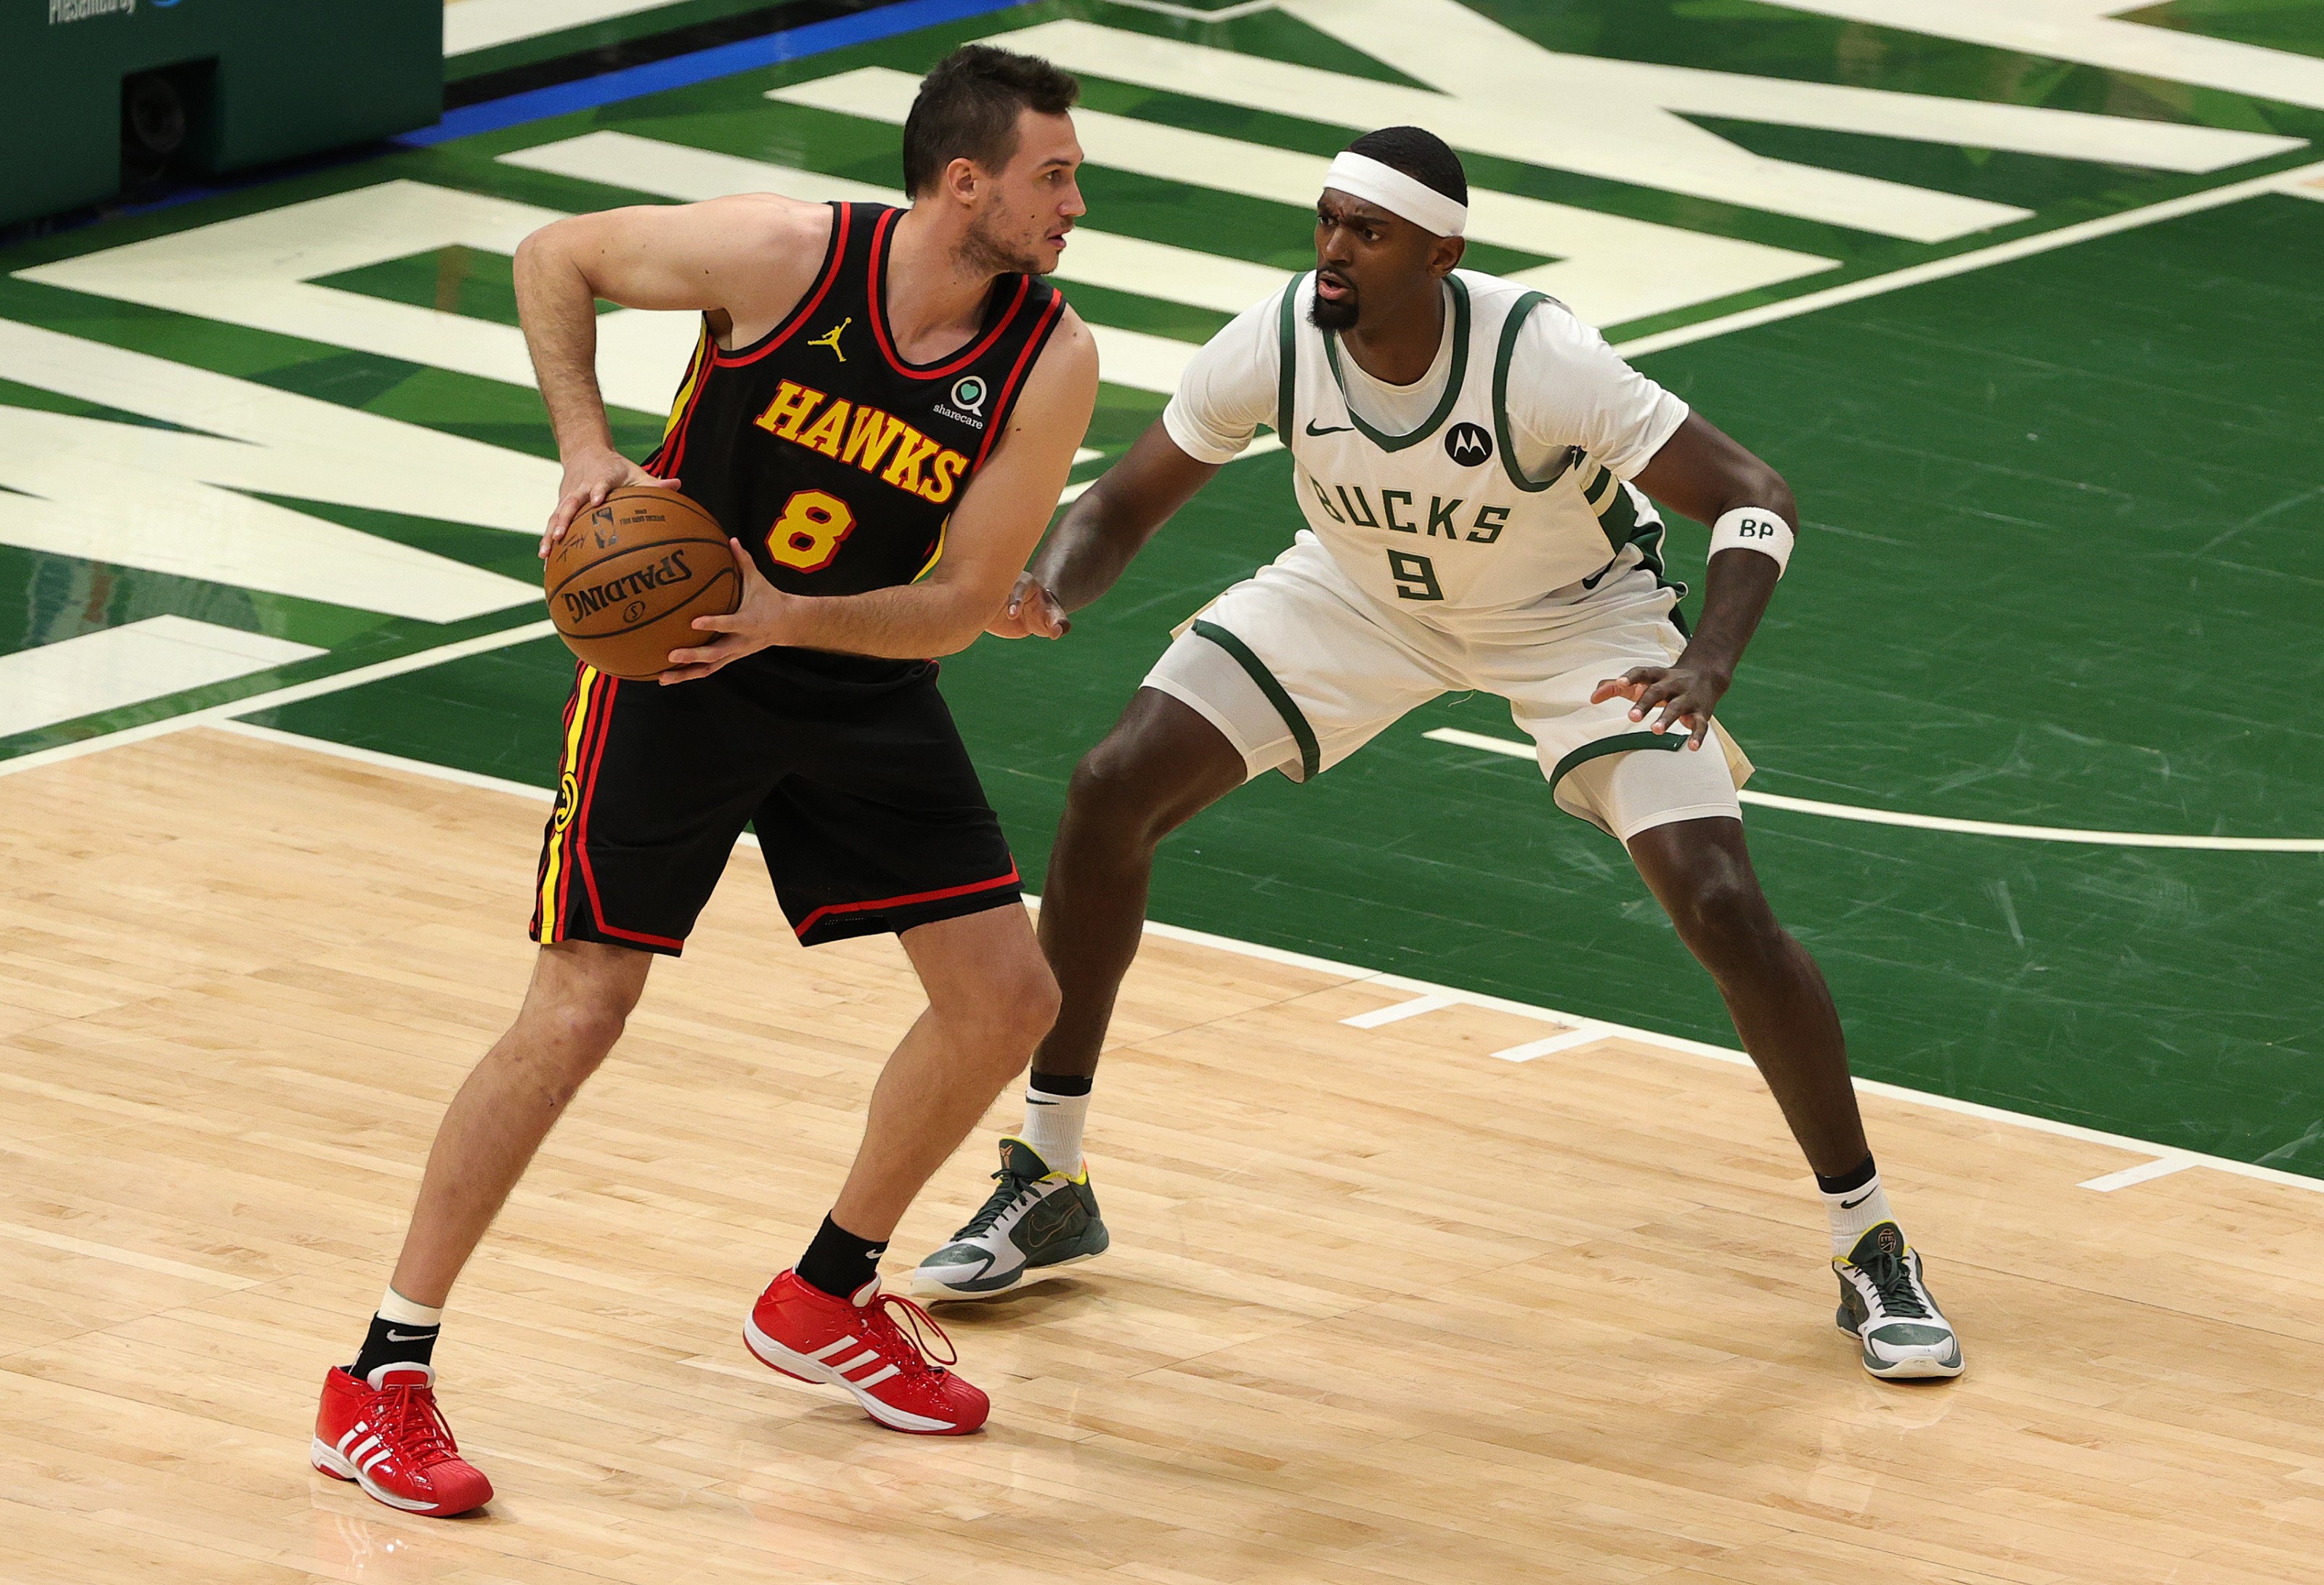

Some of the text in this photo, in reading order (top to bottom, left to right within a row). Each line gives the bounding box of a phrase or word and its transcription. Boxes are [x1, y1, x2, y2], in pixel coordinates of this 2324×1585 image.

[753, 378, 970, 503] HAWKS
[933, 402, 984, 430] sharecare
[764, 489, 858, 574] 8
[1310, 475, 1511, 544] BUCKS
[1739, 519, 1774, 539] BP
[563, 550, 692, 624] SPALDING
[1386, 548, 1445, 600] 9
